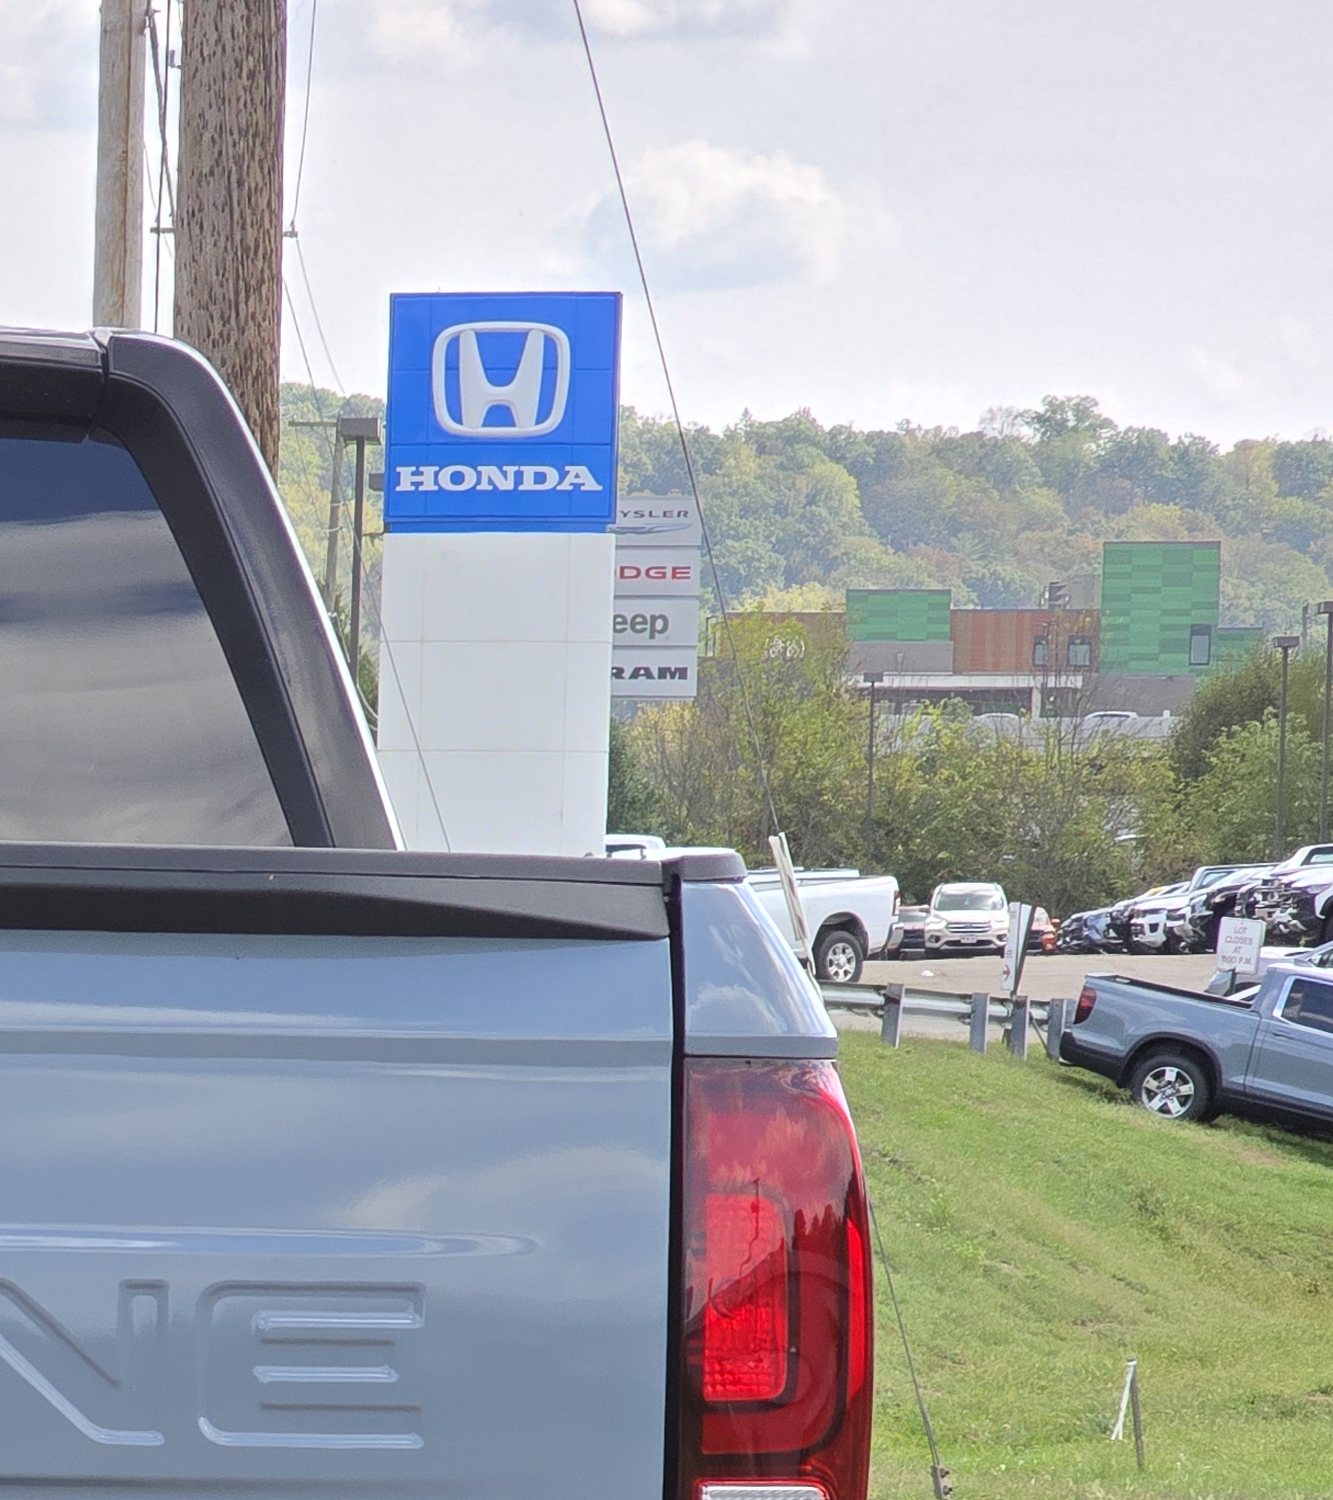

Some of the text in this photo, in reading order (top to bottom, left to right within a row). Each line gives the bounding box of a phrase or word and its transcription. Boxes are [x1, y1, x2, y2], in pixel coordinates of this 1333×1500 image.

[395, 464, 604, 492] HONDA
[618, 509, 690, 519] YSLER
[618, 565, 693, 580] DGE
[612, 612, 670, 641] eep
[610, 666, 689, 681] RAM
[1233, 926, 1248, 934] LOT
[1225, 935, 1253, 946] CLOSES
[1232, 946, 1242, 954] AT
